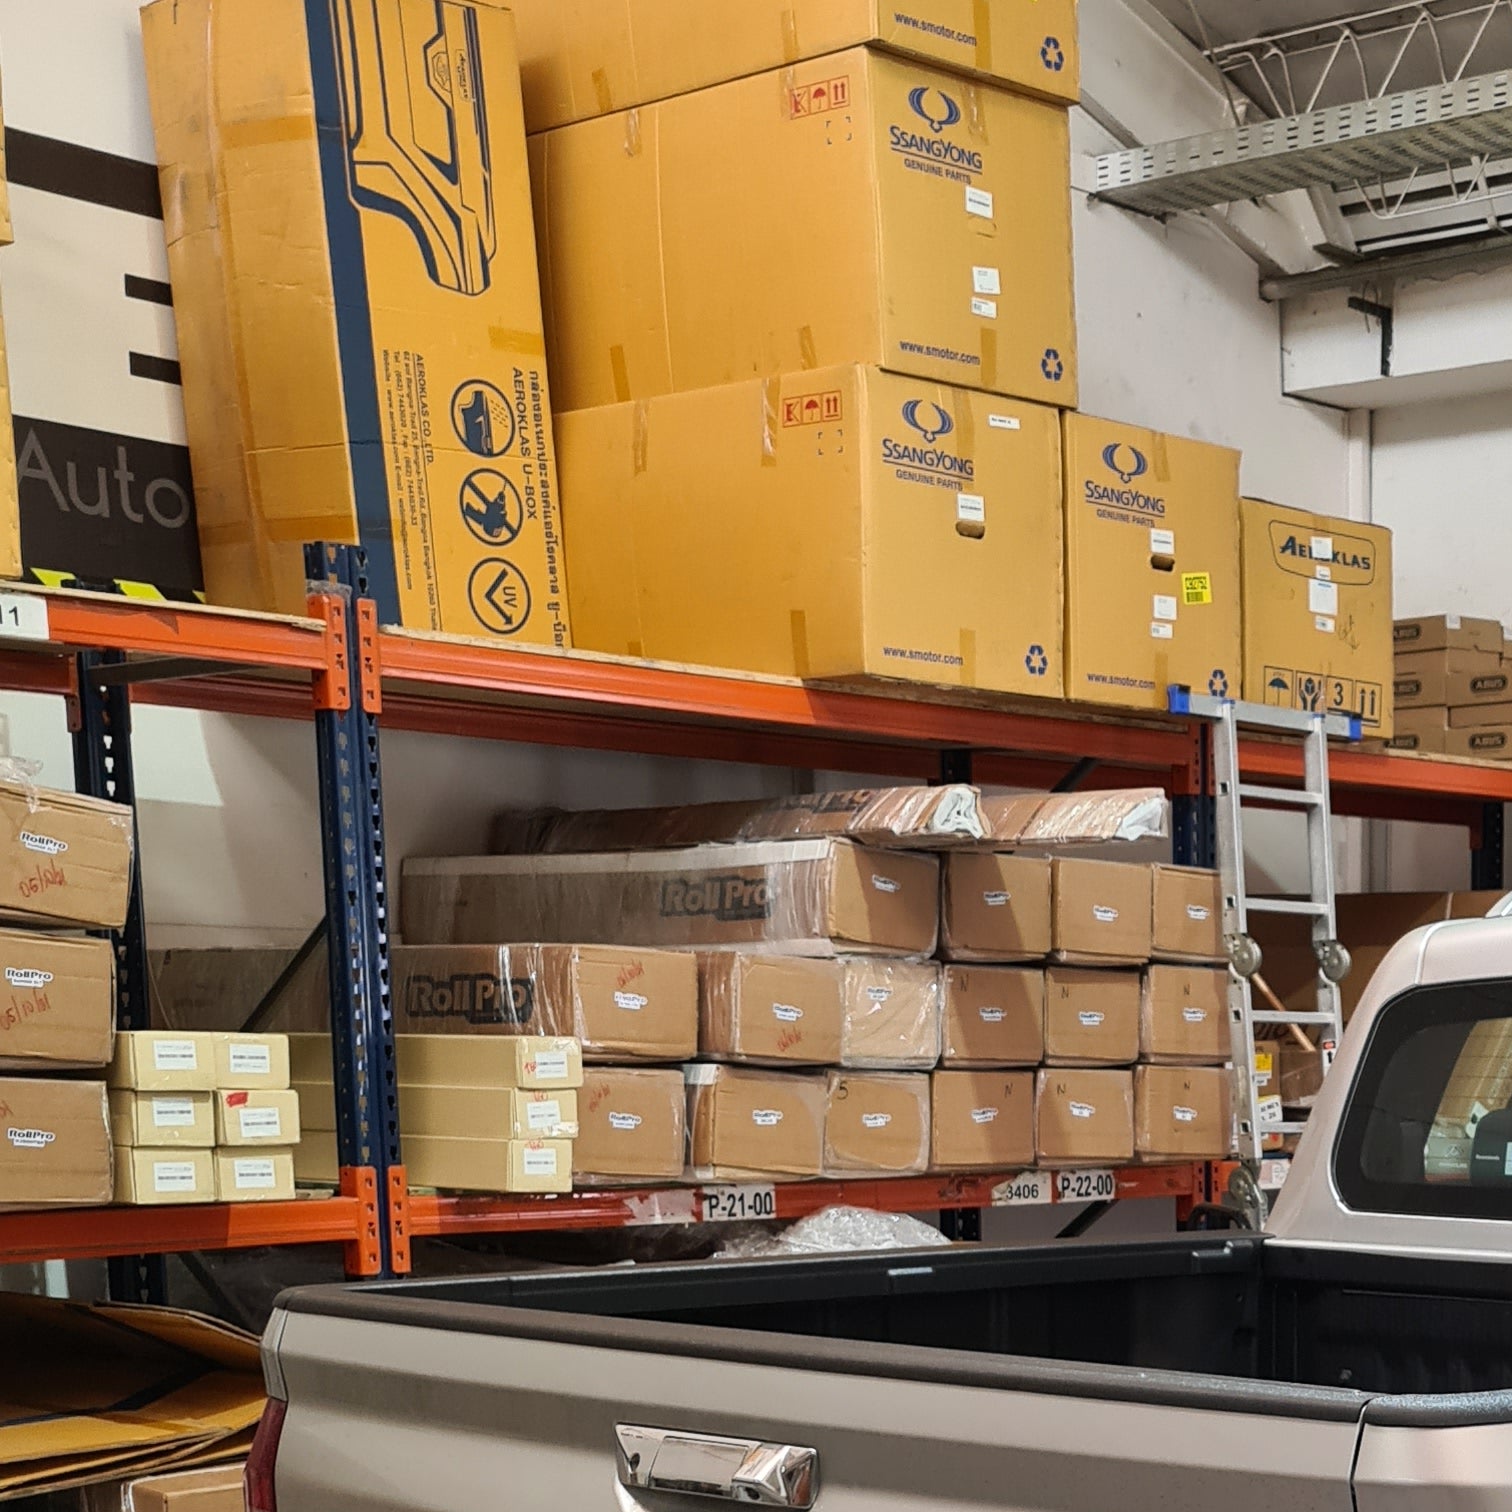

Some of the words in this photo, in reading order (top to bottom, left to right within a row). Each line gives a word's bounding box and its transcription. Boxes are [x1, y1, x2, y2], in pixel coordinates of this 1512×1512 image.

[893, 13, 978, 46] www.smotor.com
[889, 125, 983, 169] SSANGYONG
[904, 157, 944, 177] GENUINE
[945, 166, 972, 185] PARTS
[899, 341, 981, 366] www.smotor.com
[415, 353, 430, 417] AEROKLAS
[512, 367, 532, 458] AEROKLAS
[522, 463, 538, 520] U-BOX
[882, 438, 974, 476] SSANGYONG
[17, 427, 191, 529] Auto
[896, 469, 935, 486] GENUINE
[936, 477, 964, 492] PARTS
[1085, 480, 1166, 514] SSANGYONG
[1096, 508, 1130, 525] GENUINE
[1132, 517, 1156, 528] PARTS
[1280, 535, 1371, 570] AEKLAS
[502, 586, 518, 609] UV
[882, 646, 964, 666] www.smotor.com
[1087, 672, 1156, 690] www.smotor.com
[1333, 682, 1344, 706] 3
[21, 832, 66, 850] RollPro
[7, 969, 52, 980] RollPro
[410, 976, 530, 1014] RollPro
[9, 1129, 54, 1140] RollPro
[1006, 1183, 1040, 1200] 3406
[1061, 1174, 1113, 1198] P-22-00
[708, 1191, 773, 1218] P-21-00
